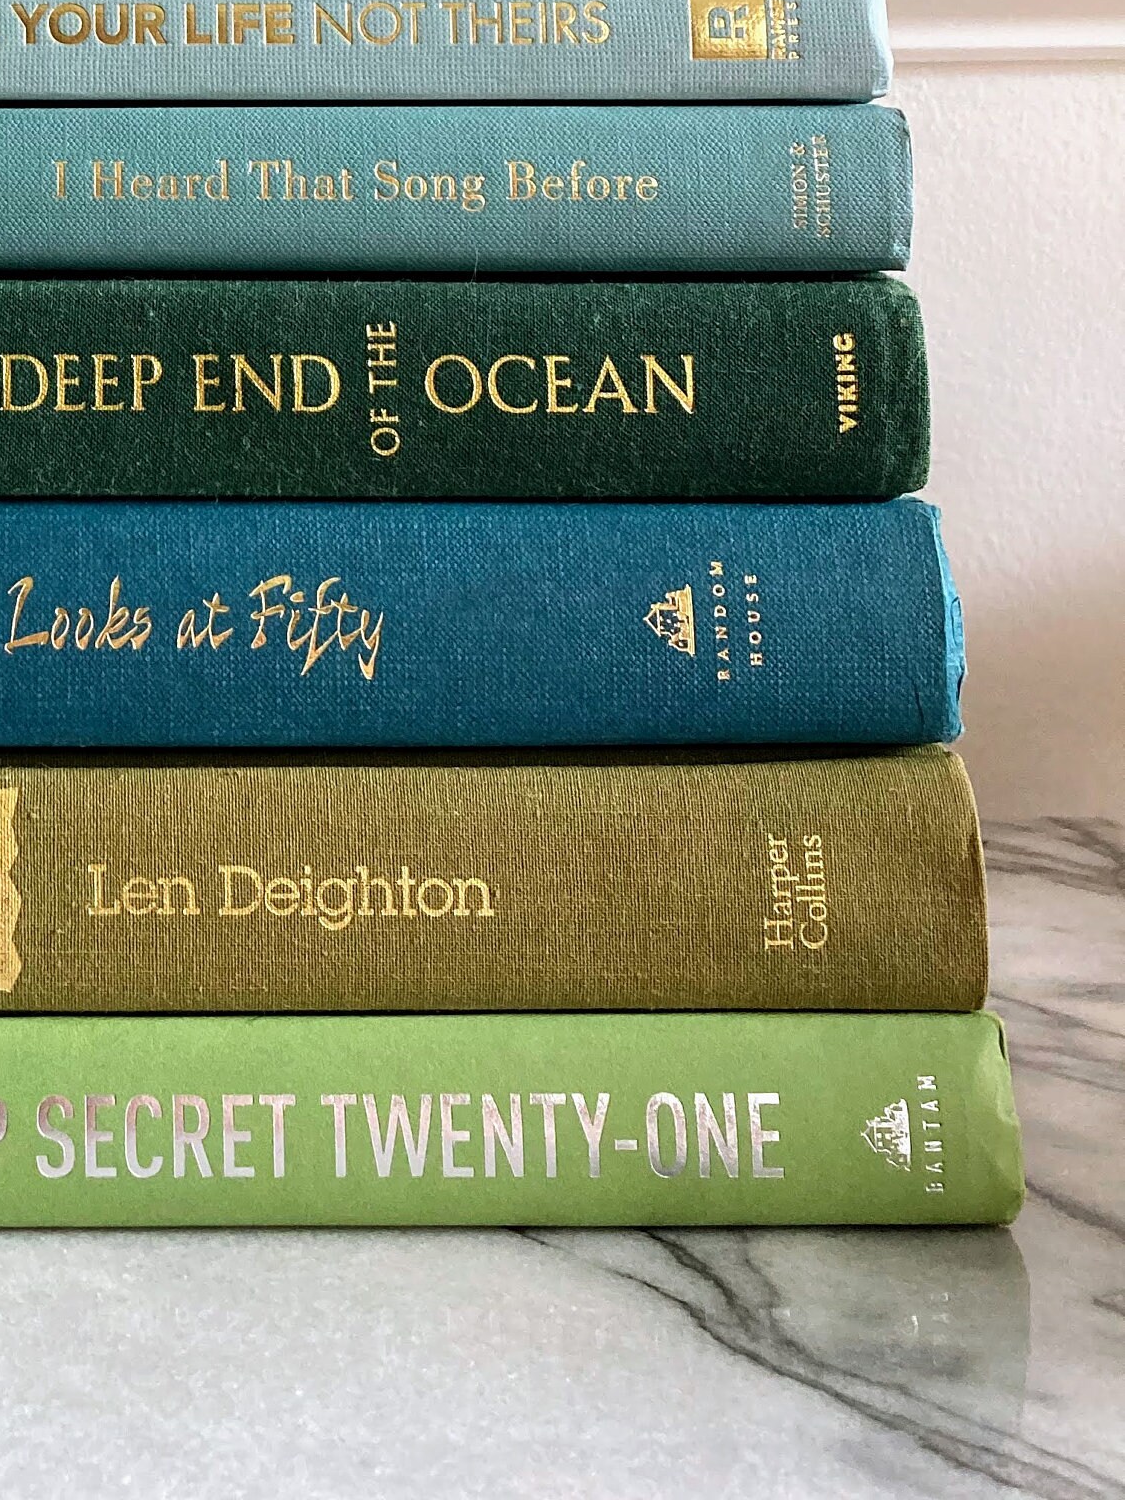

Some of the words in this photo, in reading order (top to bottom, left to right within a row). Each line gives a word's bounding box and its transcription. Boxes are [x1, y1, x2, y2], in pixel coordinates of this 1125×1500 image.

[11, 3, 169, 46] YOUR
[185, 3, 295, 45] LIFE
[314, 3, 426, 44] NOT
[440, 1, 611, 44] THEIRS
[52, 160, 69, 200] I
[92, 160, 230, 200] Heard
[249, 159, 355, 200] That
[374, 161, 487, 211] Song
[505, 159, 661, 201] Before
[791, 164, 808, 230] SIMON
[812, 134, 831, 238] SCHUSTER
[0, 353, 162, 412] DEEP
[192, 353, 342, 412] END
[366, 320, 397, 390] THE
[424, 353, 696, 415] OCEAN
[831, 333, 859, 434] VIKING
[369, 400, 402, 457] OF
[2, 574, 153, 655] Looks
[177, 592, 233, 651] at
[249, 574, 385, 681] Fifty
[709, 559, 732, 681] RANDOM
[744, 572, 763, 666] HOUSE
[85, 861, 200, 917] Len
[219, 866, 497, 930] Deighton
[763, 833, 793, 950] Harper
[796, 833, 827, 950] Collins
[35, 1093, 296, 1181] SECRET
[321, 1090, 786, 1180] TWENTY-ONE
[918, 1073, 945, 1194] BANTAM
